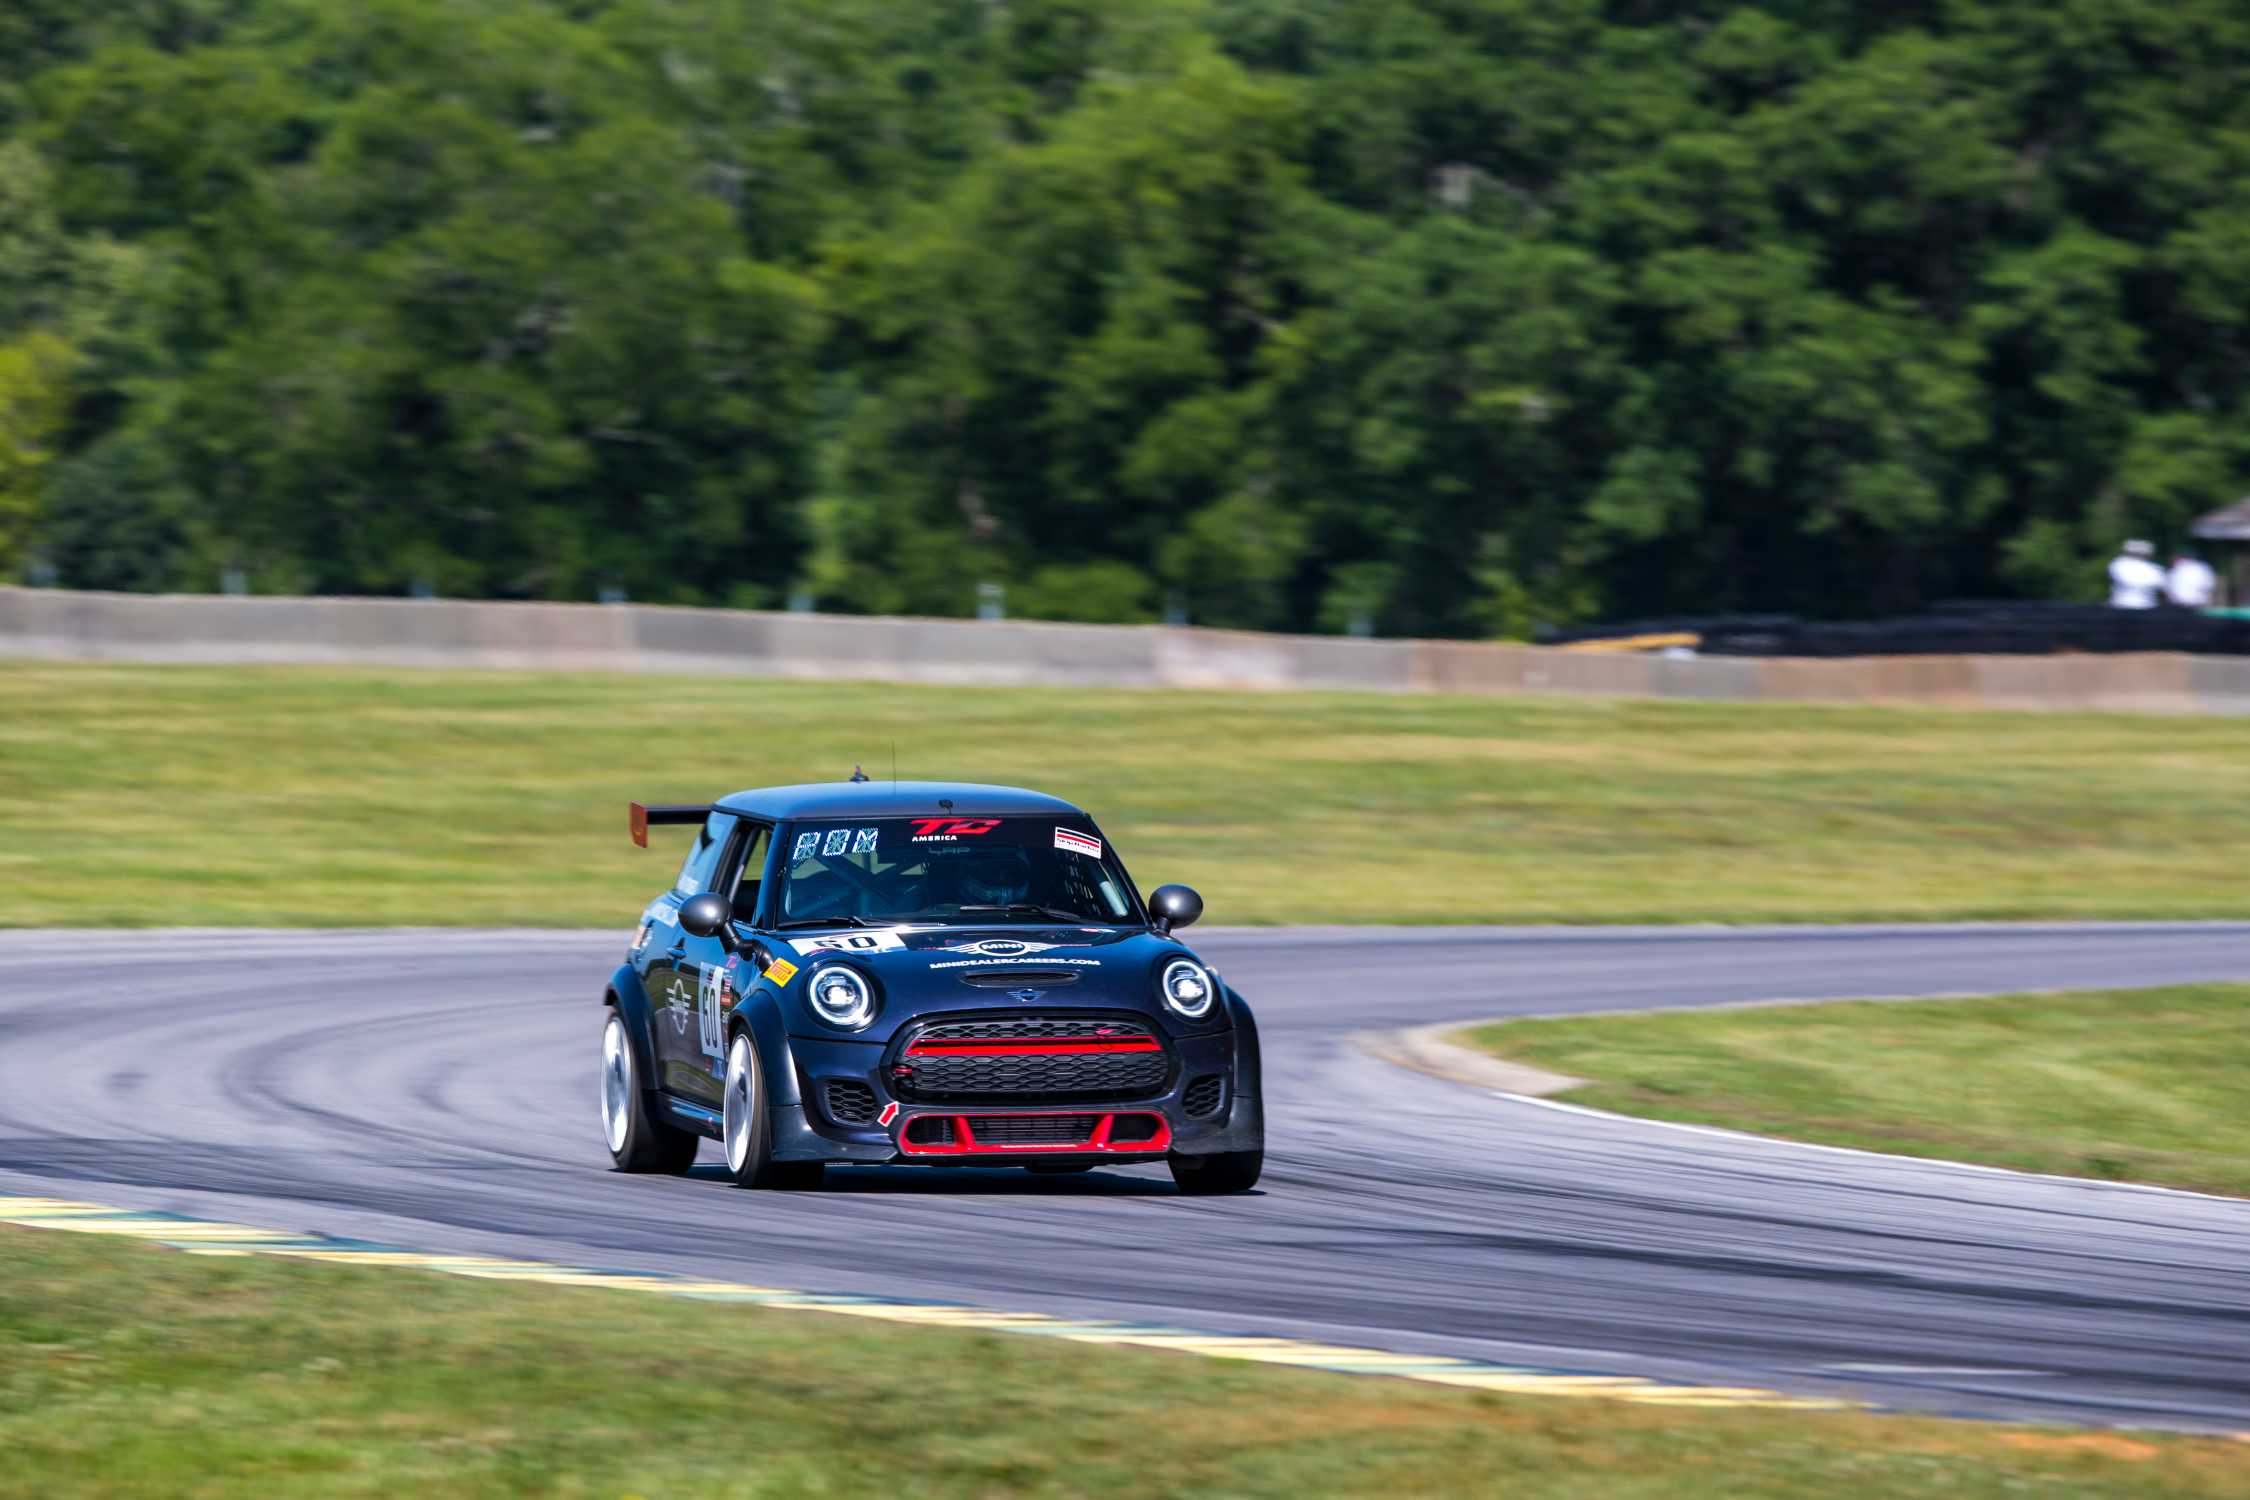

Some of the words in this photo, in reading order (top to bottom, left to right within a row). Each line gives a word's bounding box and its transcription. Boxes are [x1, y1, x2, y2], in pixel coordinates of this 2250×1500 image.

[911, 817, 1002, 835] TC
[911, 835, 957, 843] AMERICA
[929, 958, 1101, 969] MINIDEALERCAREERS.COM
[702, 986, 718, 1048] 60
